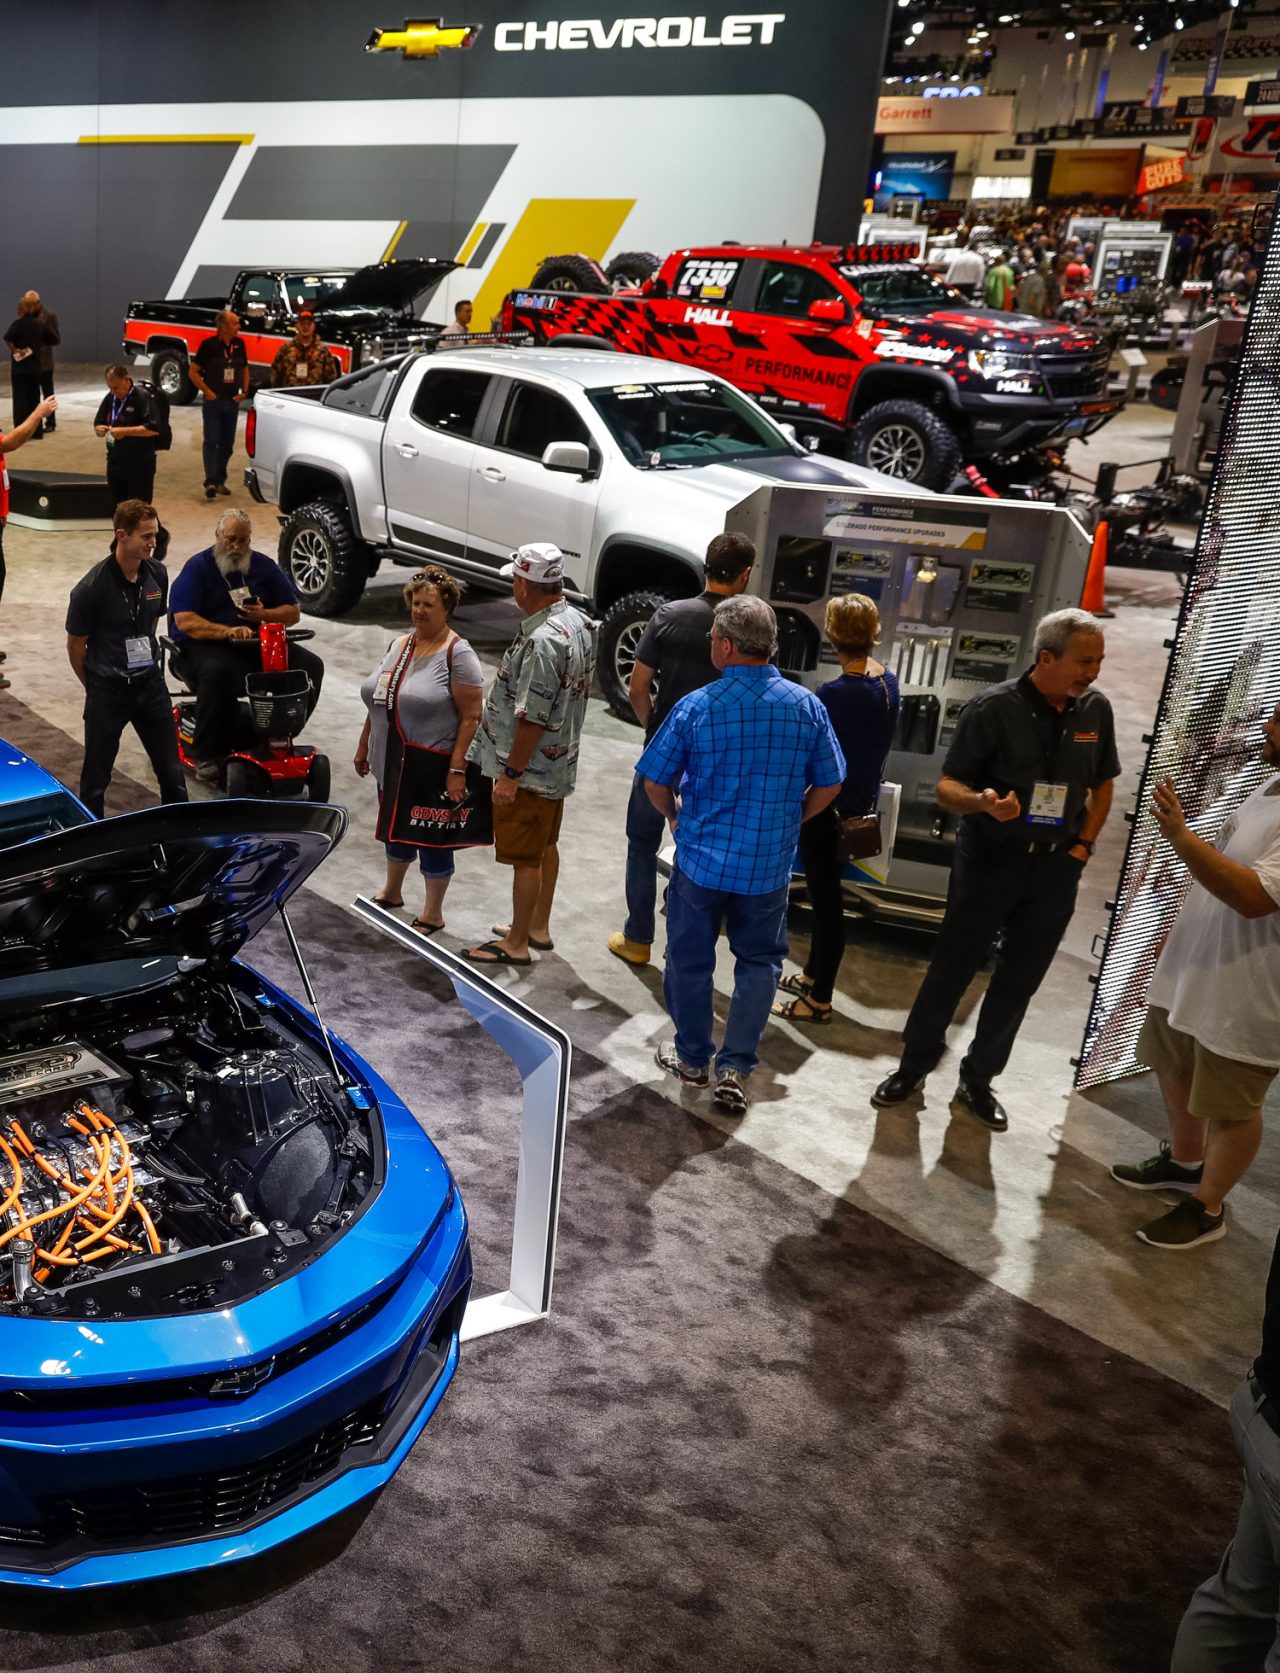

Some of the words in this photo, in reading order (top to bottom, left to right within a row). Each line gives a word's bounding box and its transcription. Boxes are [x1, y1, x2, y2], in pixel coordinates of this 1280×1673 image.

[494, 13, 786, 51] CHEVROLET
[880, 106, 932, 120] Garrett
[684, 307, 734, 327] HALL
[744, 356, 854, 391] PERFORMANCE
[996, 380, 1033, 393] HALL
[872, 506, 914, 515] PERFORMANCE
[868, 524, 912, 535] PERFORMANCE
[913, 528, 946, 538] UPGRADES
[411, 806, 470, 822] ODYSY
